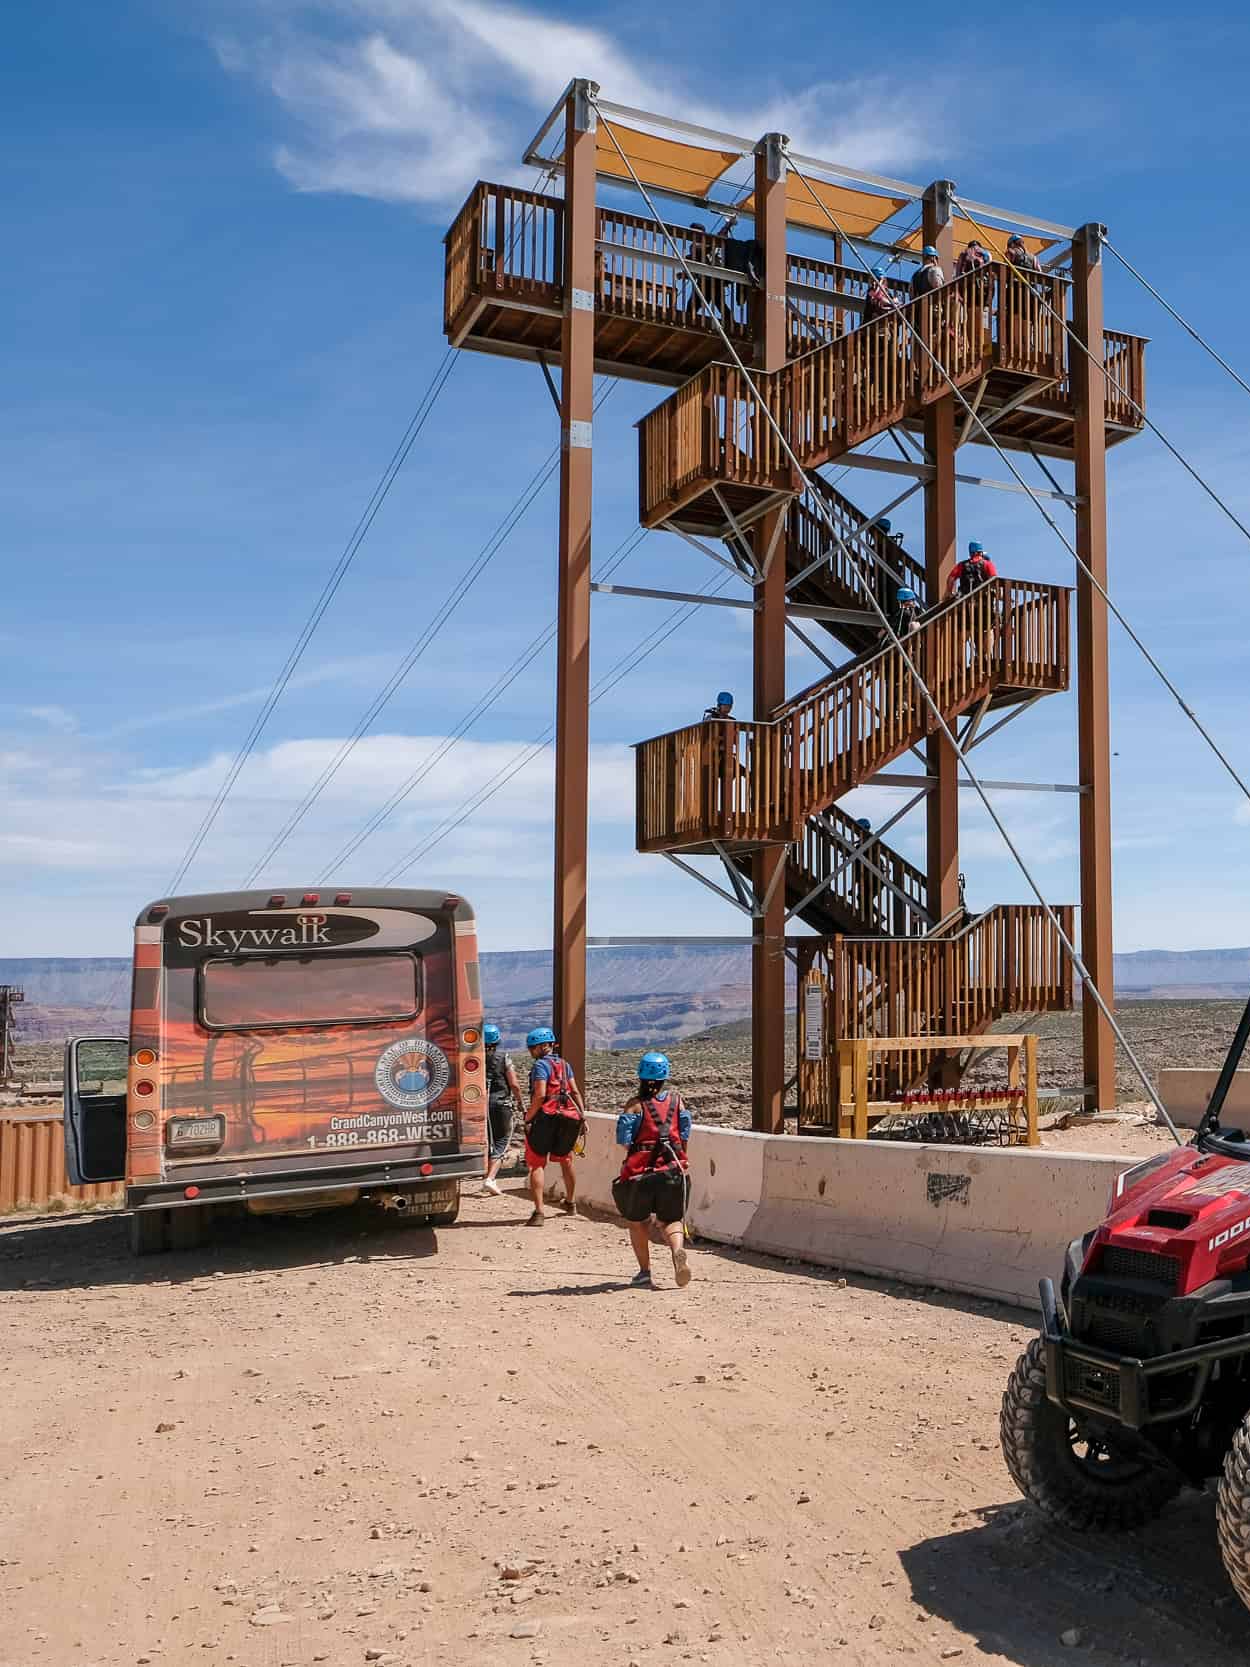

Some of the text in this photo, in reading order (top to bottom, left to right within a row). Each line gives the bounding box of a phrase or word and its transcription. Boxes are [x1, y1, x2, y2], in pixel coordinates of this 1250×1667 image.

[178, 917, 333, 953] Skywalk
[330, 1110, 454, 1130] GrandCanyonWest.com
[306, 1123, 454, 1149] 1-888-868-WEST
